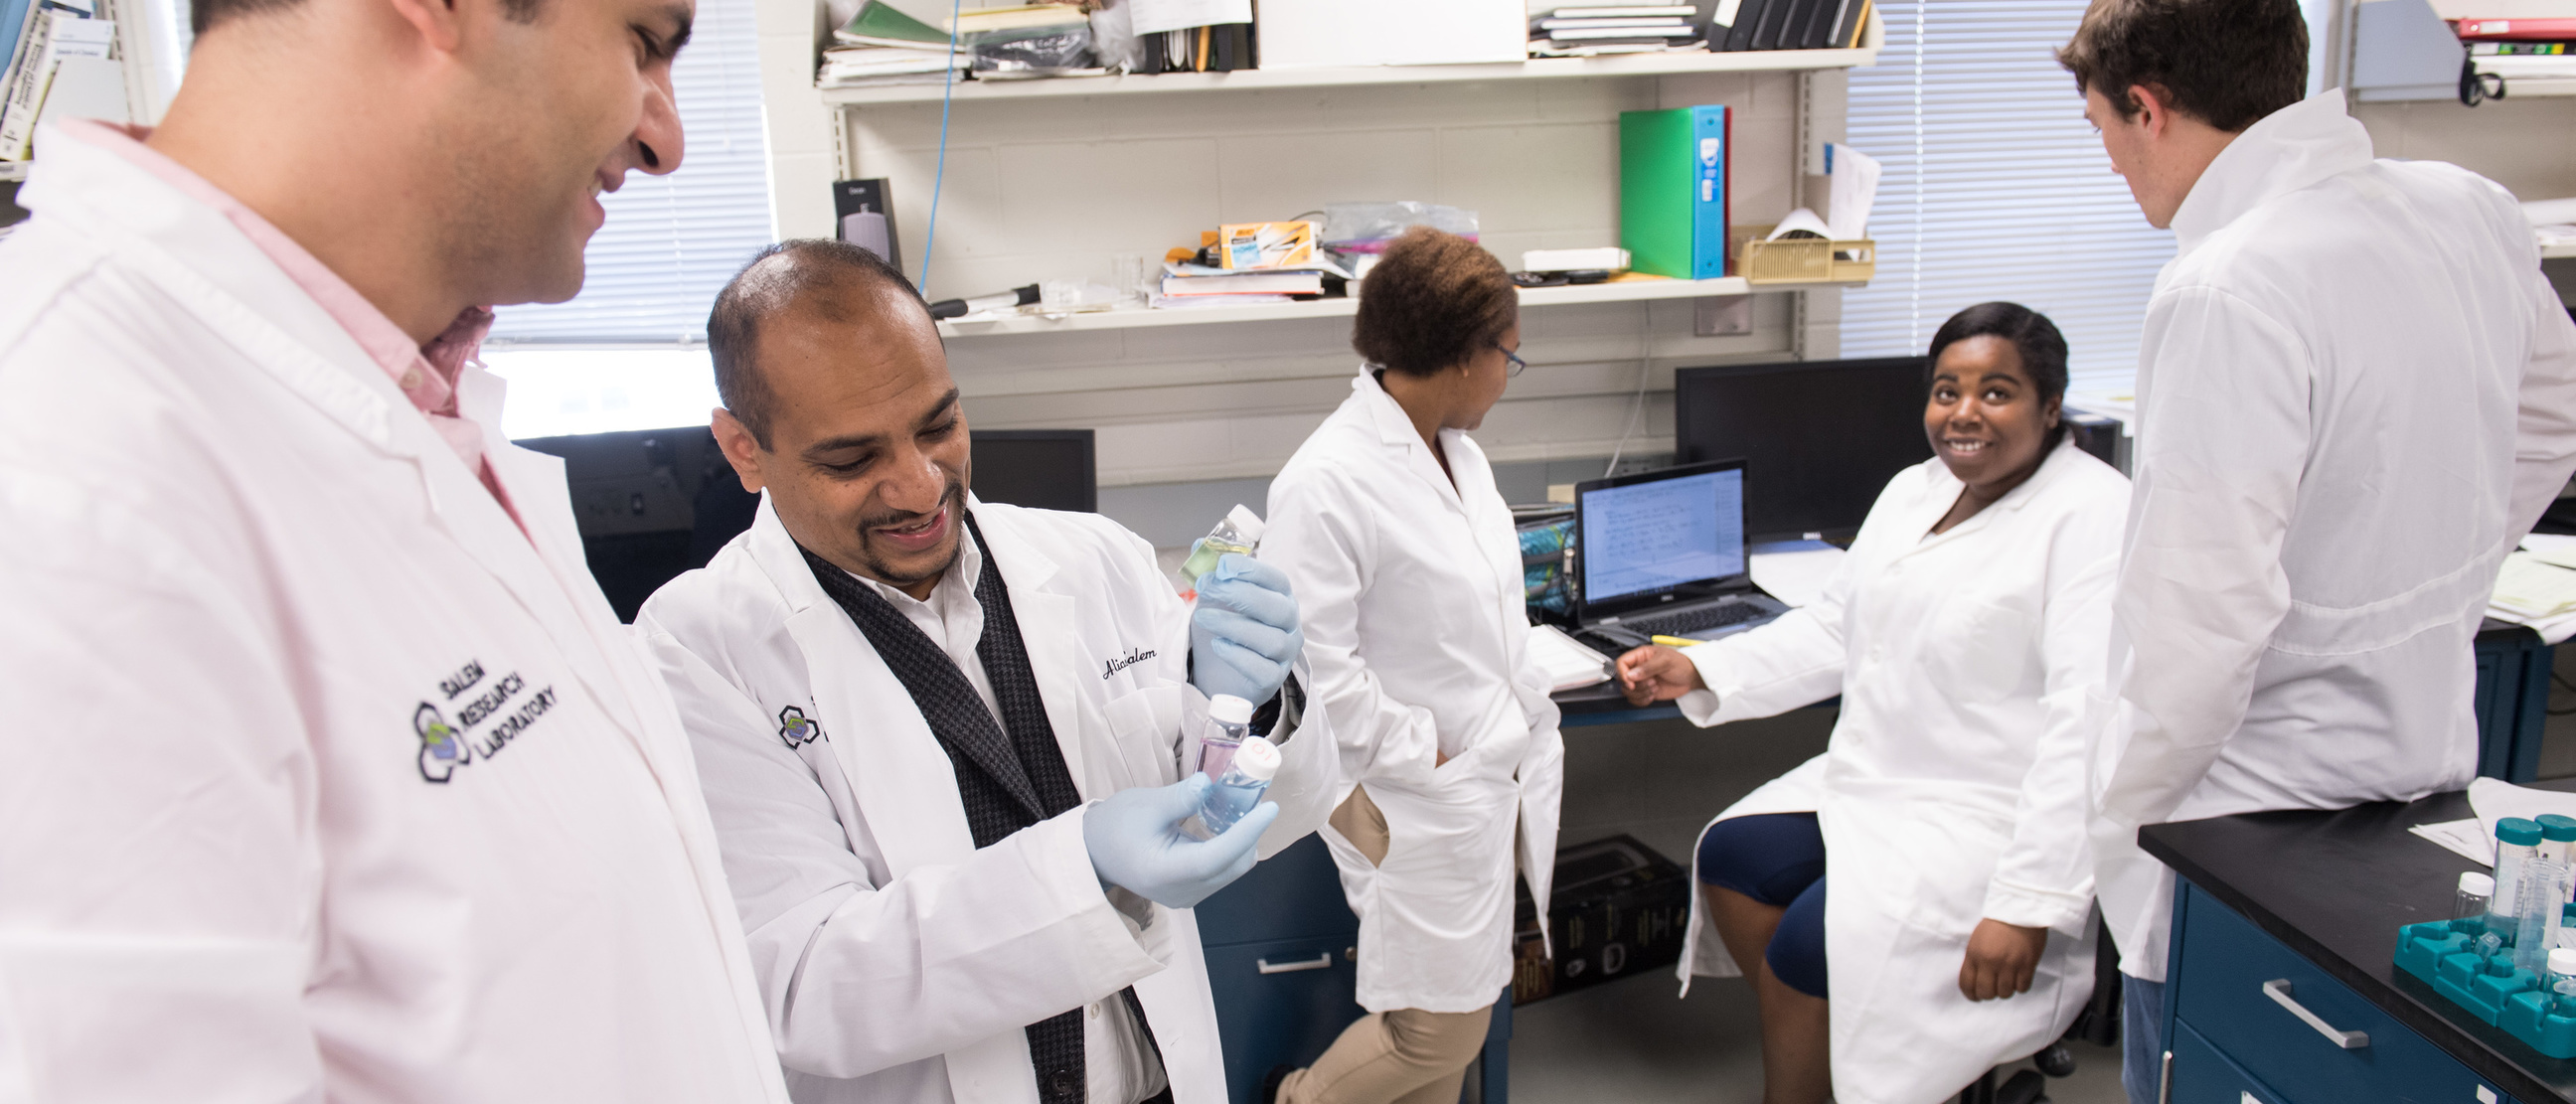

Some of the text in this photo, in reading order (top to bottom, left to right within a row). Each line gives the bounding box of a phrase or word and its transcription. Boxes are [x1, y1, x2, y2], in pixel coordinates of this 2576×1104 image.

[439, 659, 485, 701] SALEM
[458, 671, 525, 732] RESEARCH
[473, 685, 557, 760] LABORATORY
